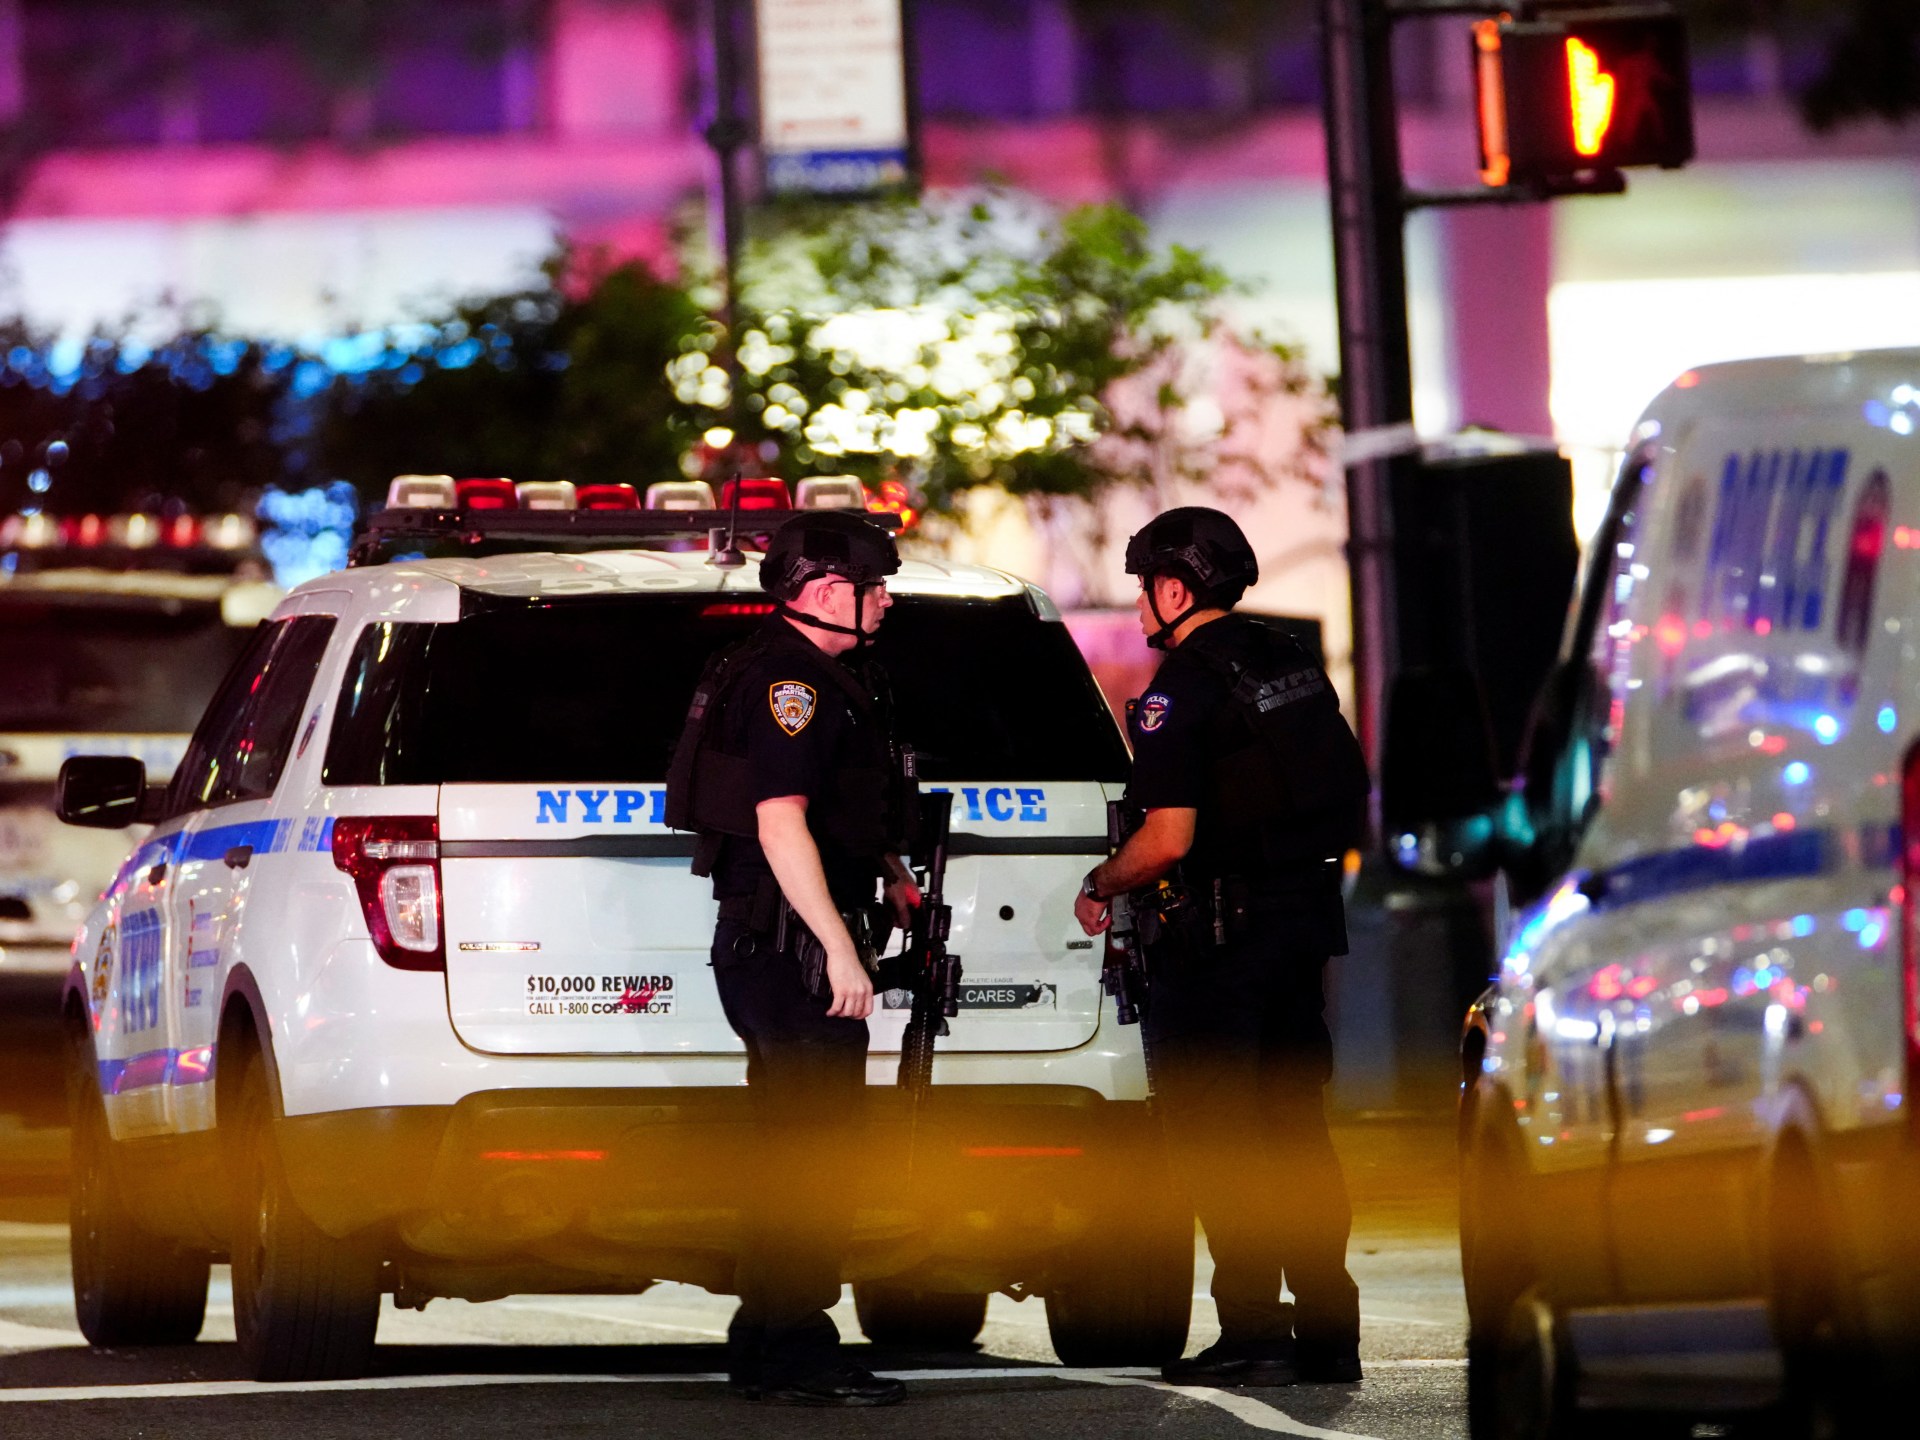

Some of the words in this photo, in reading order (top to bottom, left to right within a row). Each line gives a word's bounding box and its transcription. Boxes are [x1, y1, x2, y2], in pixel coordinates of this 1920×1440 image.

[775, 690, 812, 701] DEPARTMENT
[1146, 696, 1168, 706] POLICE
[774, 704, 782, 716] CITY
[930, 788, 1047, 822] ICE
[527, 975, 596, 995] $10,000
[602, 975, 674, 992] REWARD
[966, 989, 1016, 1003] CARES
[529, 1002, 555, 1015] CALL
[559, 1002, 589, 1015] 1-800
[591, 1002, 623, 1014] COP
[624, 1001, 672, 1015] SHOT
